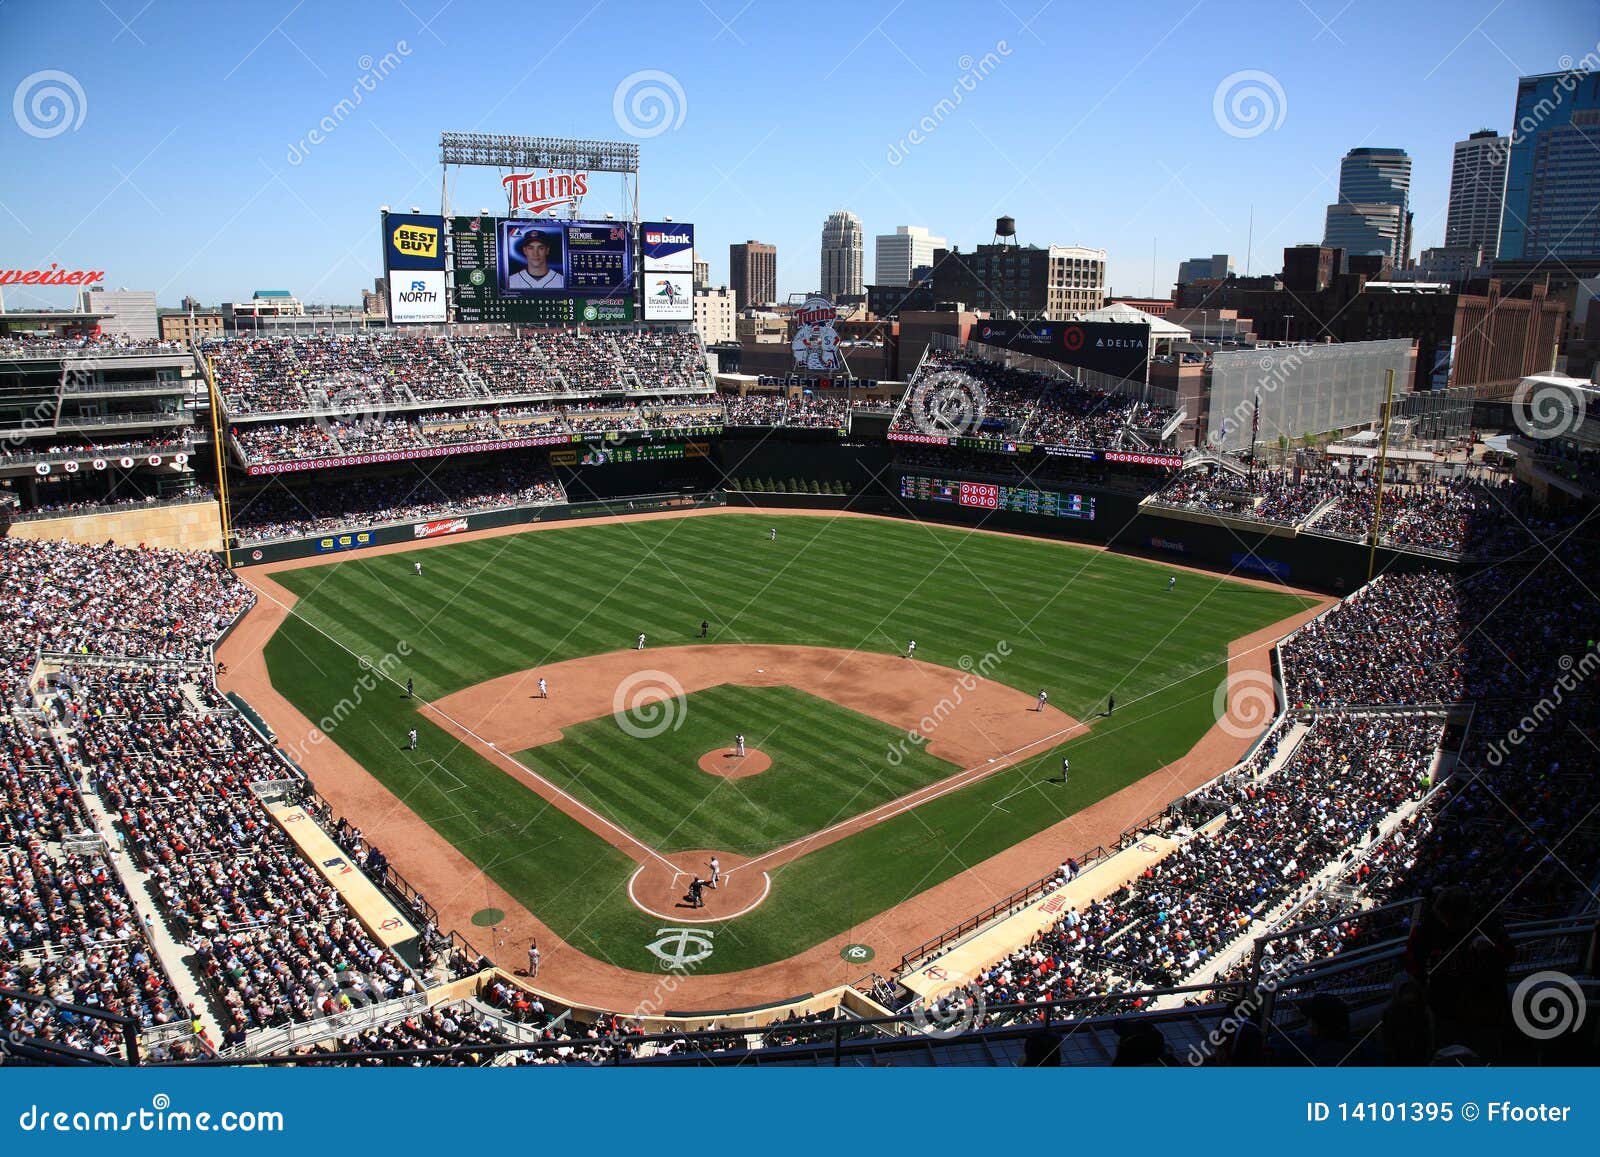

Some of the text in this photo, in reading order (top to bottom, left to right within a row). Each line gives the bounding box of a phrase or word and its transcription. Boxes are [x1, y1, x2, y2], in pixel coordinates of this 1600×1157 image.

[502, 167, 588, 214] Twins
[399, 230, 436, 243] BEST
[401, 240, 432, 252] BUY
[411, 281, 426, 291] FS
[399, 291, 437, 303] NORTH
[794, 307, 837, 328] Twins
[1106, 338, 1144, 348] DELTA
[758, 378, 878, 388] TARGET FIELD
